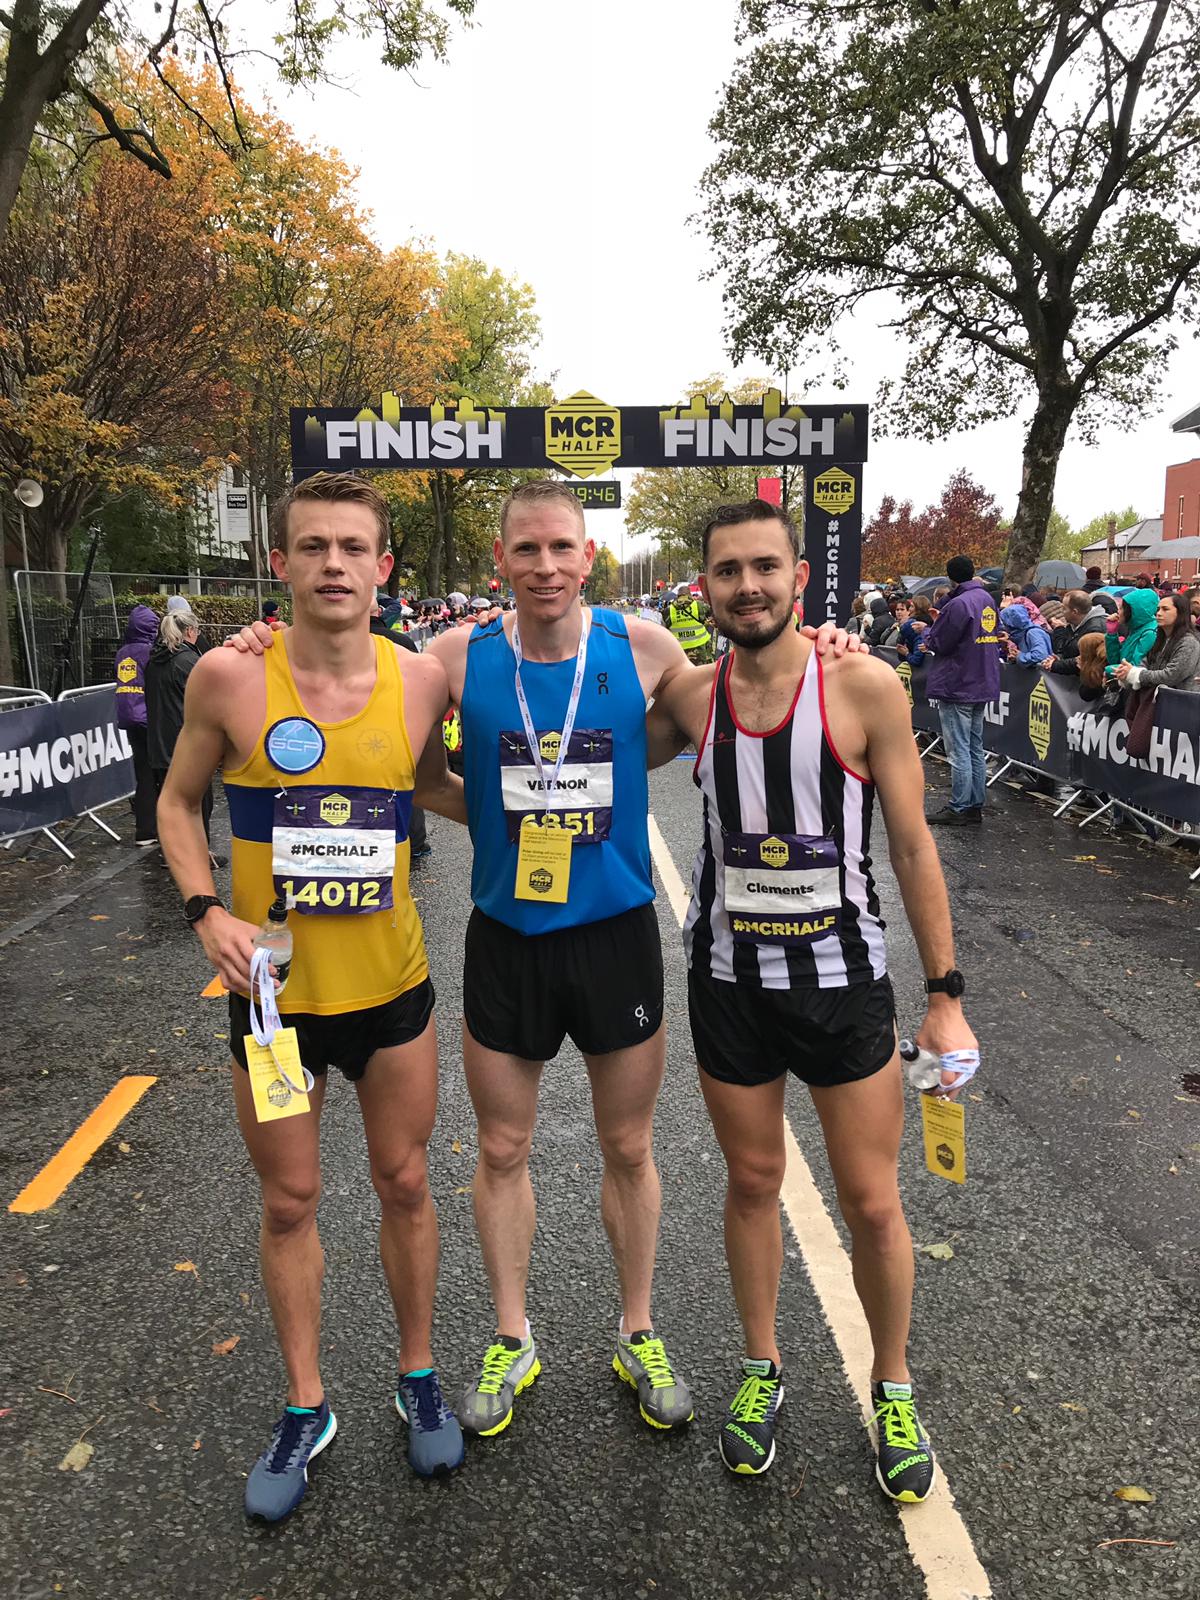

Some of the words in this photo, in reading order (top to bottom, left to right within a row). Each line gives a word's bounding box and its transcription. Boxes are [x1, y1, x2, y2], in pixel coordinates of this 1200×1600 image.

[551, 416, 615, 438] MCR
[664, 418, 835, 457] FINISH
[326, 420, 502, 460] FINISH
[562, 440, 604, 451] HALF
[816, 481, 852, 494] MCR
[1031, 700, 1049, 725] MCR
[1067, 711, 1200, 786] #MCHA
[322, 802, 348, 811] MCR
[290, 844, 378, 857] #MCRHALF
[762, 845, 786, 854] MCR
[531, 875, 552, 883] MCR
[746, 883, 814, 895] Clements
[282, 880, 380, 907] 14012
[733, 916, 836, 936] #MCRHALF
[725, 1423, 765, 1456] BROOKS
[887, 1453, 929, 1480] BROOKS
